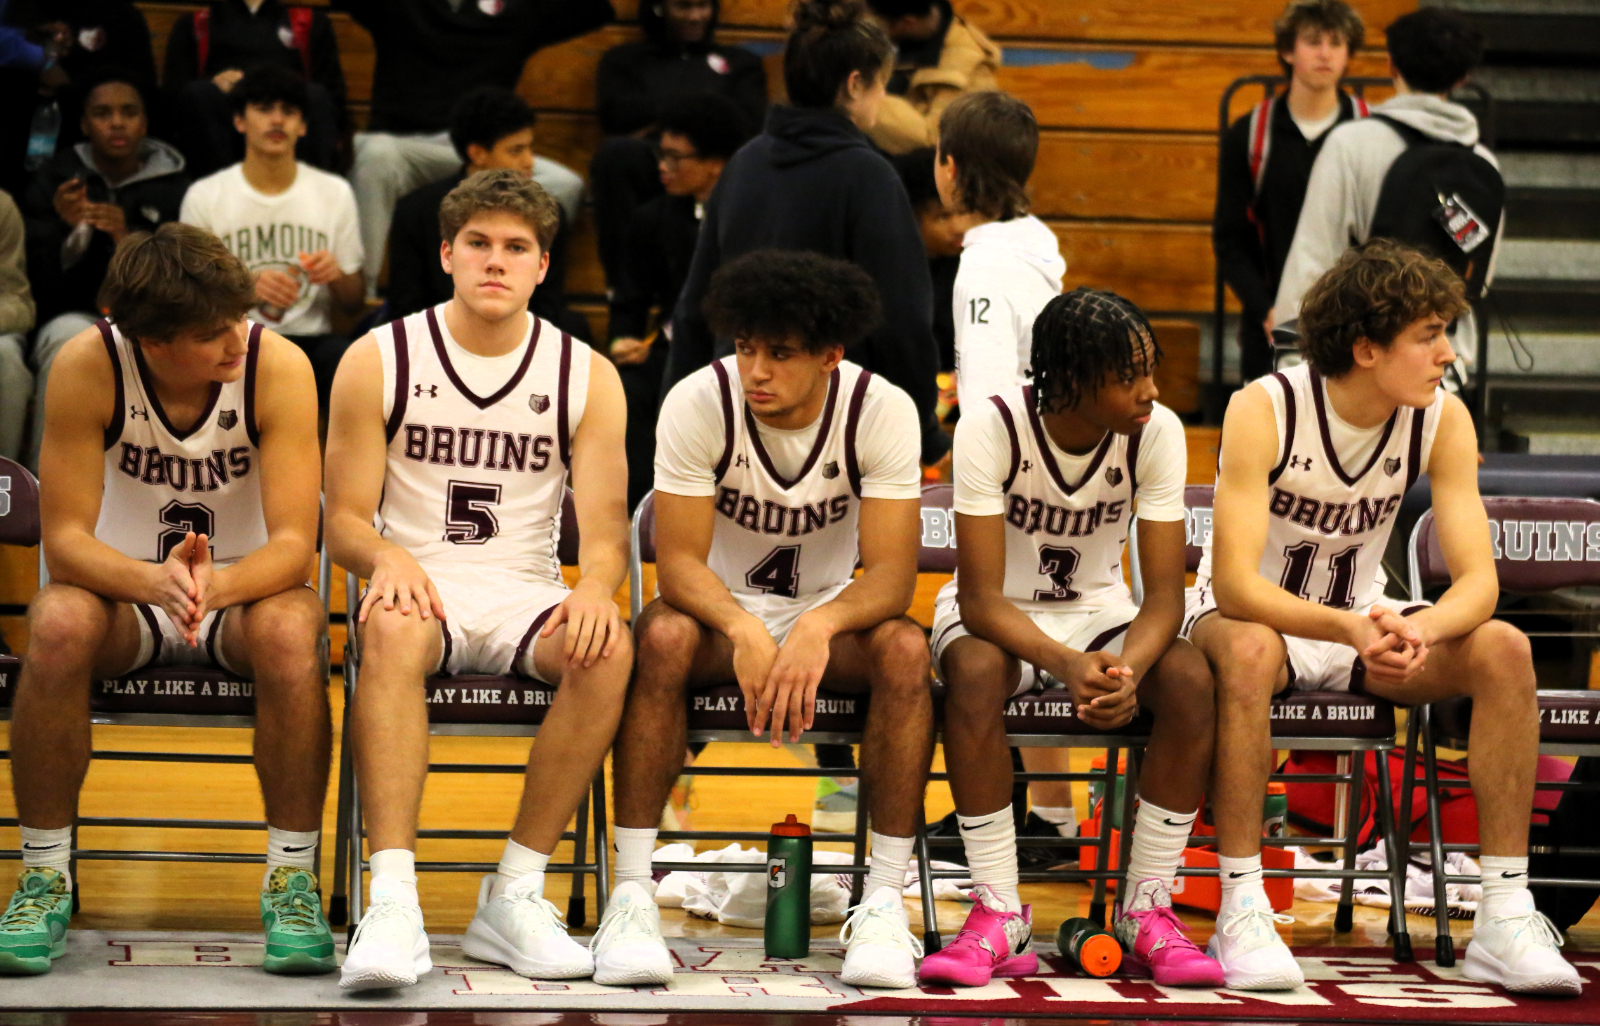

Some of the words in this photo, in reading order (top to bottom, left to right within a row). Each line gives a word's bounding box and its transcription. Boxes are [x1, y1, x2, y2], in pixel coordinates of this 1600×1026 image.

[968, 298, 991, 325] 12
[118, 441, 252, 492] BRUINS
[404, 424, 554, 473] BRUINS
[157, 499, 215, 563] 2
[442, 479, 503, 545] 5
[715, 485, 851, 537] BRUINS
[1006, 493, 1127, 538] BRUINS
[1269, 487, 1402, 536] BRUINS
[745, 544, 801, 599] 4
[1033, 543, 1082, 601] 3
[1279, 540, 1363, 608] 11
[102, 679, 148, 695] PLAY
[153, 680, 195, 696] LIKE
[200, 681, 213, 696] A
[461, 688, 502, 704] LIKE
[507, 690, 519, 705] A
[693, 696, 739, 711] PLAY
[1033, 702, 1072, 718] LIKE
[1269, 705, 1307, 720] LIKE
[1311, 705, 1322, 720] A
[1326, 705, 1376, 720] BRUIN
[1550, 709, 1590, 725] LIKE
[767, 858, 786, 888] G
